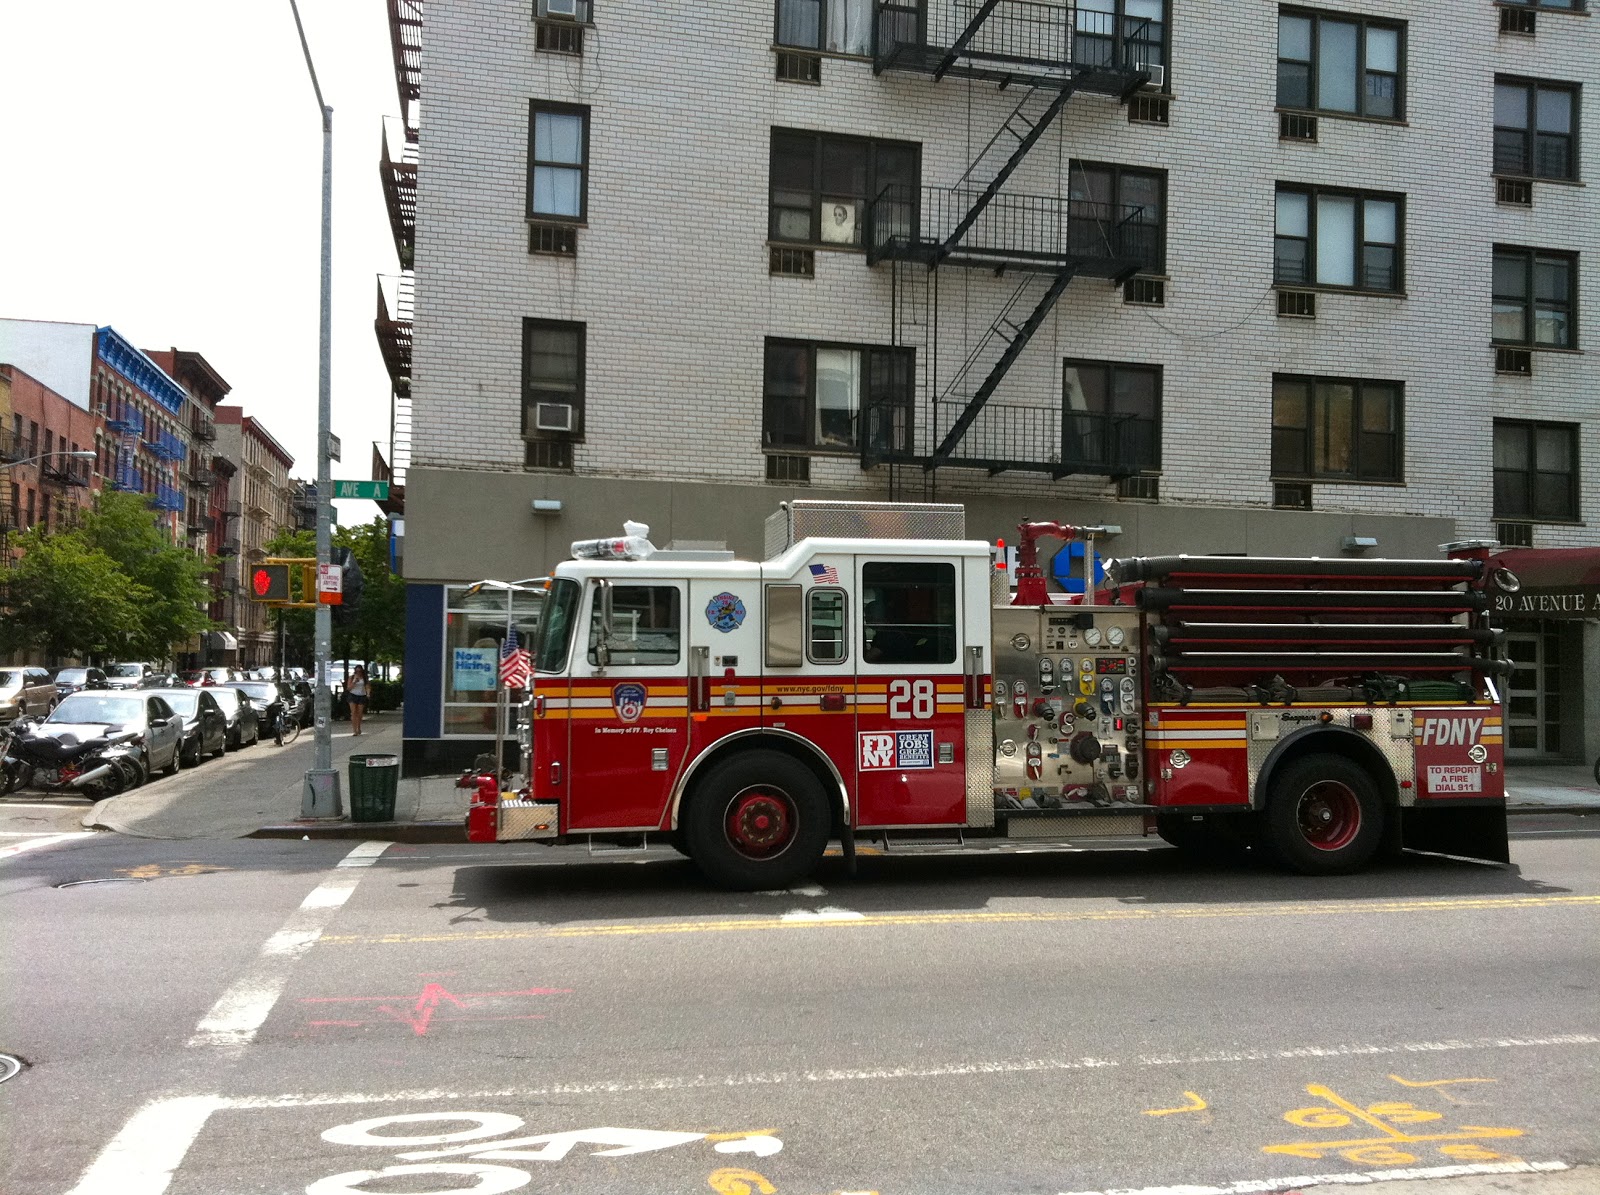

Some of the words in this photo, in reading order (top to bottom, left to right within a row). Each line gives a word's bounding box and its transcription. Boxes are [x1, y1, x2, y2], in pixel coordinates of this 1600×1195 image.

[340, 482, 360, 497] AVE
[373, 483, 381, 498] A
[1495, 595, 1514, 611] 20
[1519, 593, 1586, 612] AVENUE
[456, 652, 483, 661] Now
[455, 661, 492, 672] Hiring
[777, 685, 844, 693] www.nyc.gov/fdny
[890, 680, 934, 719] 28
[602, 727, 625, 735] Memory
[1422, 718, 1483, 745] FDNY
[862, 735, 894, 751] FD
[899, 740, 929, 749] JOBS
[863, 750, 894, 767] NY
